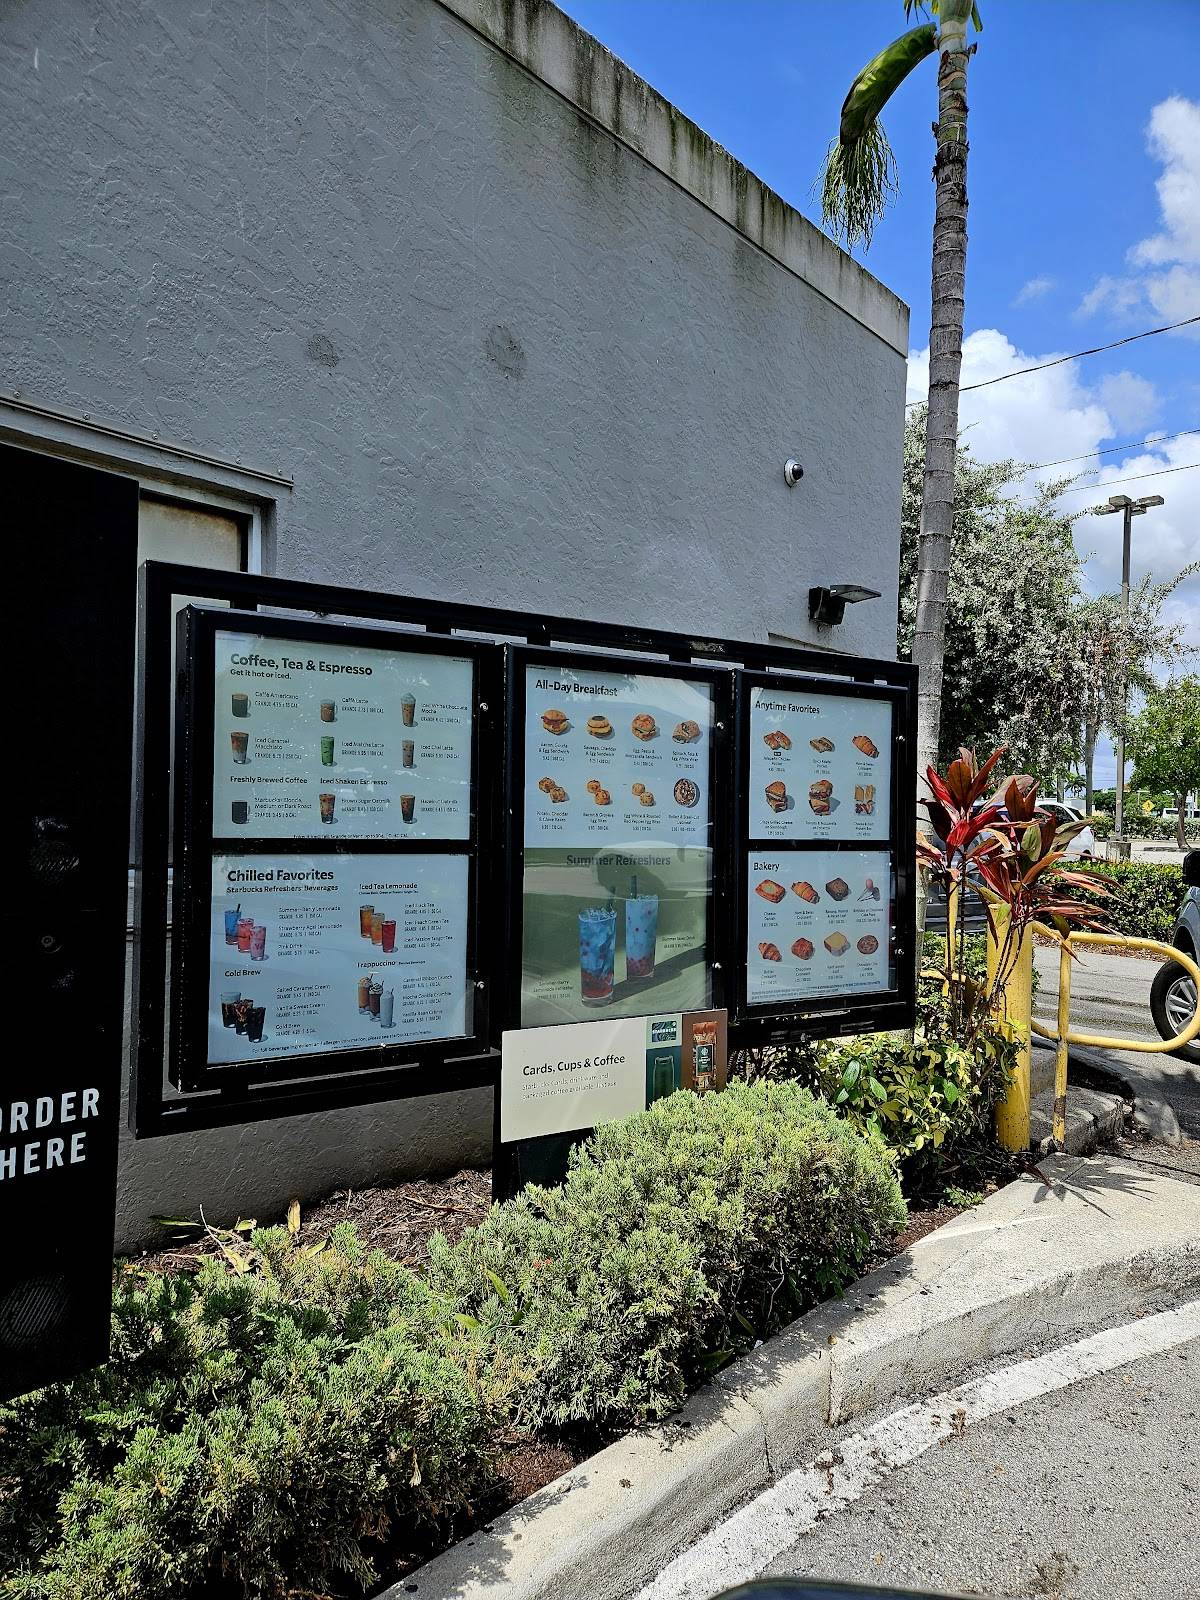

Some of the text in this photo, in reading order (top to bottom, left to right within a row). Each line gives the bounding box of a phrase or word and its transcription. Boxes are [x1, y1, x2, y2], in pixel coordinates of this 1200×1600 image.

[230, 653, 373, 675] Coffee, Tea & Espresso
[230, 668, 244, 676] Get
[252, 670, 265, 678] hot
[274, 672, 292, 680] iced.
[535, 679, 618, 697] All-Day Breakfast
[755, 700, 820, 714] Anytime Favorites
[230, 776, 308, 784] Freshly Brewed Coffee
[566, 854, 671, 865] Summer Refreshers
[753, 861, 780, 872] Bakery
[227, 869, 334, 881] Chilled Favorites
[224, 968, 262, 977] Cold Brew
[522, 1054, 626, 1076] Cards, Cups & Coffee
[0, 1088, 100, 1134] RDER
[0, 1131, 87, 1181] HERE
